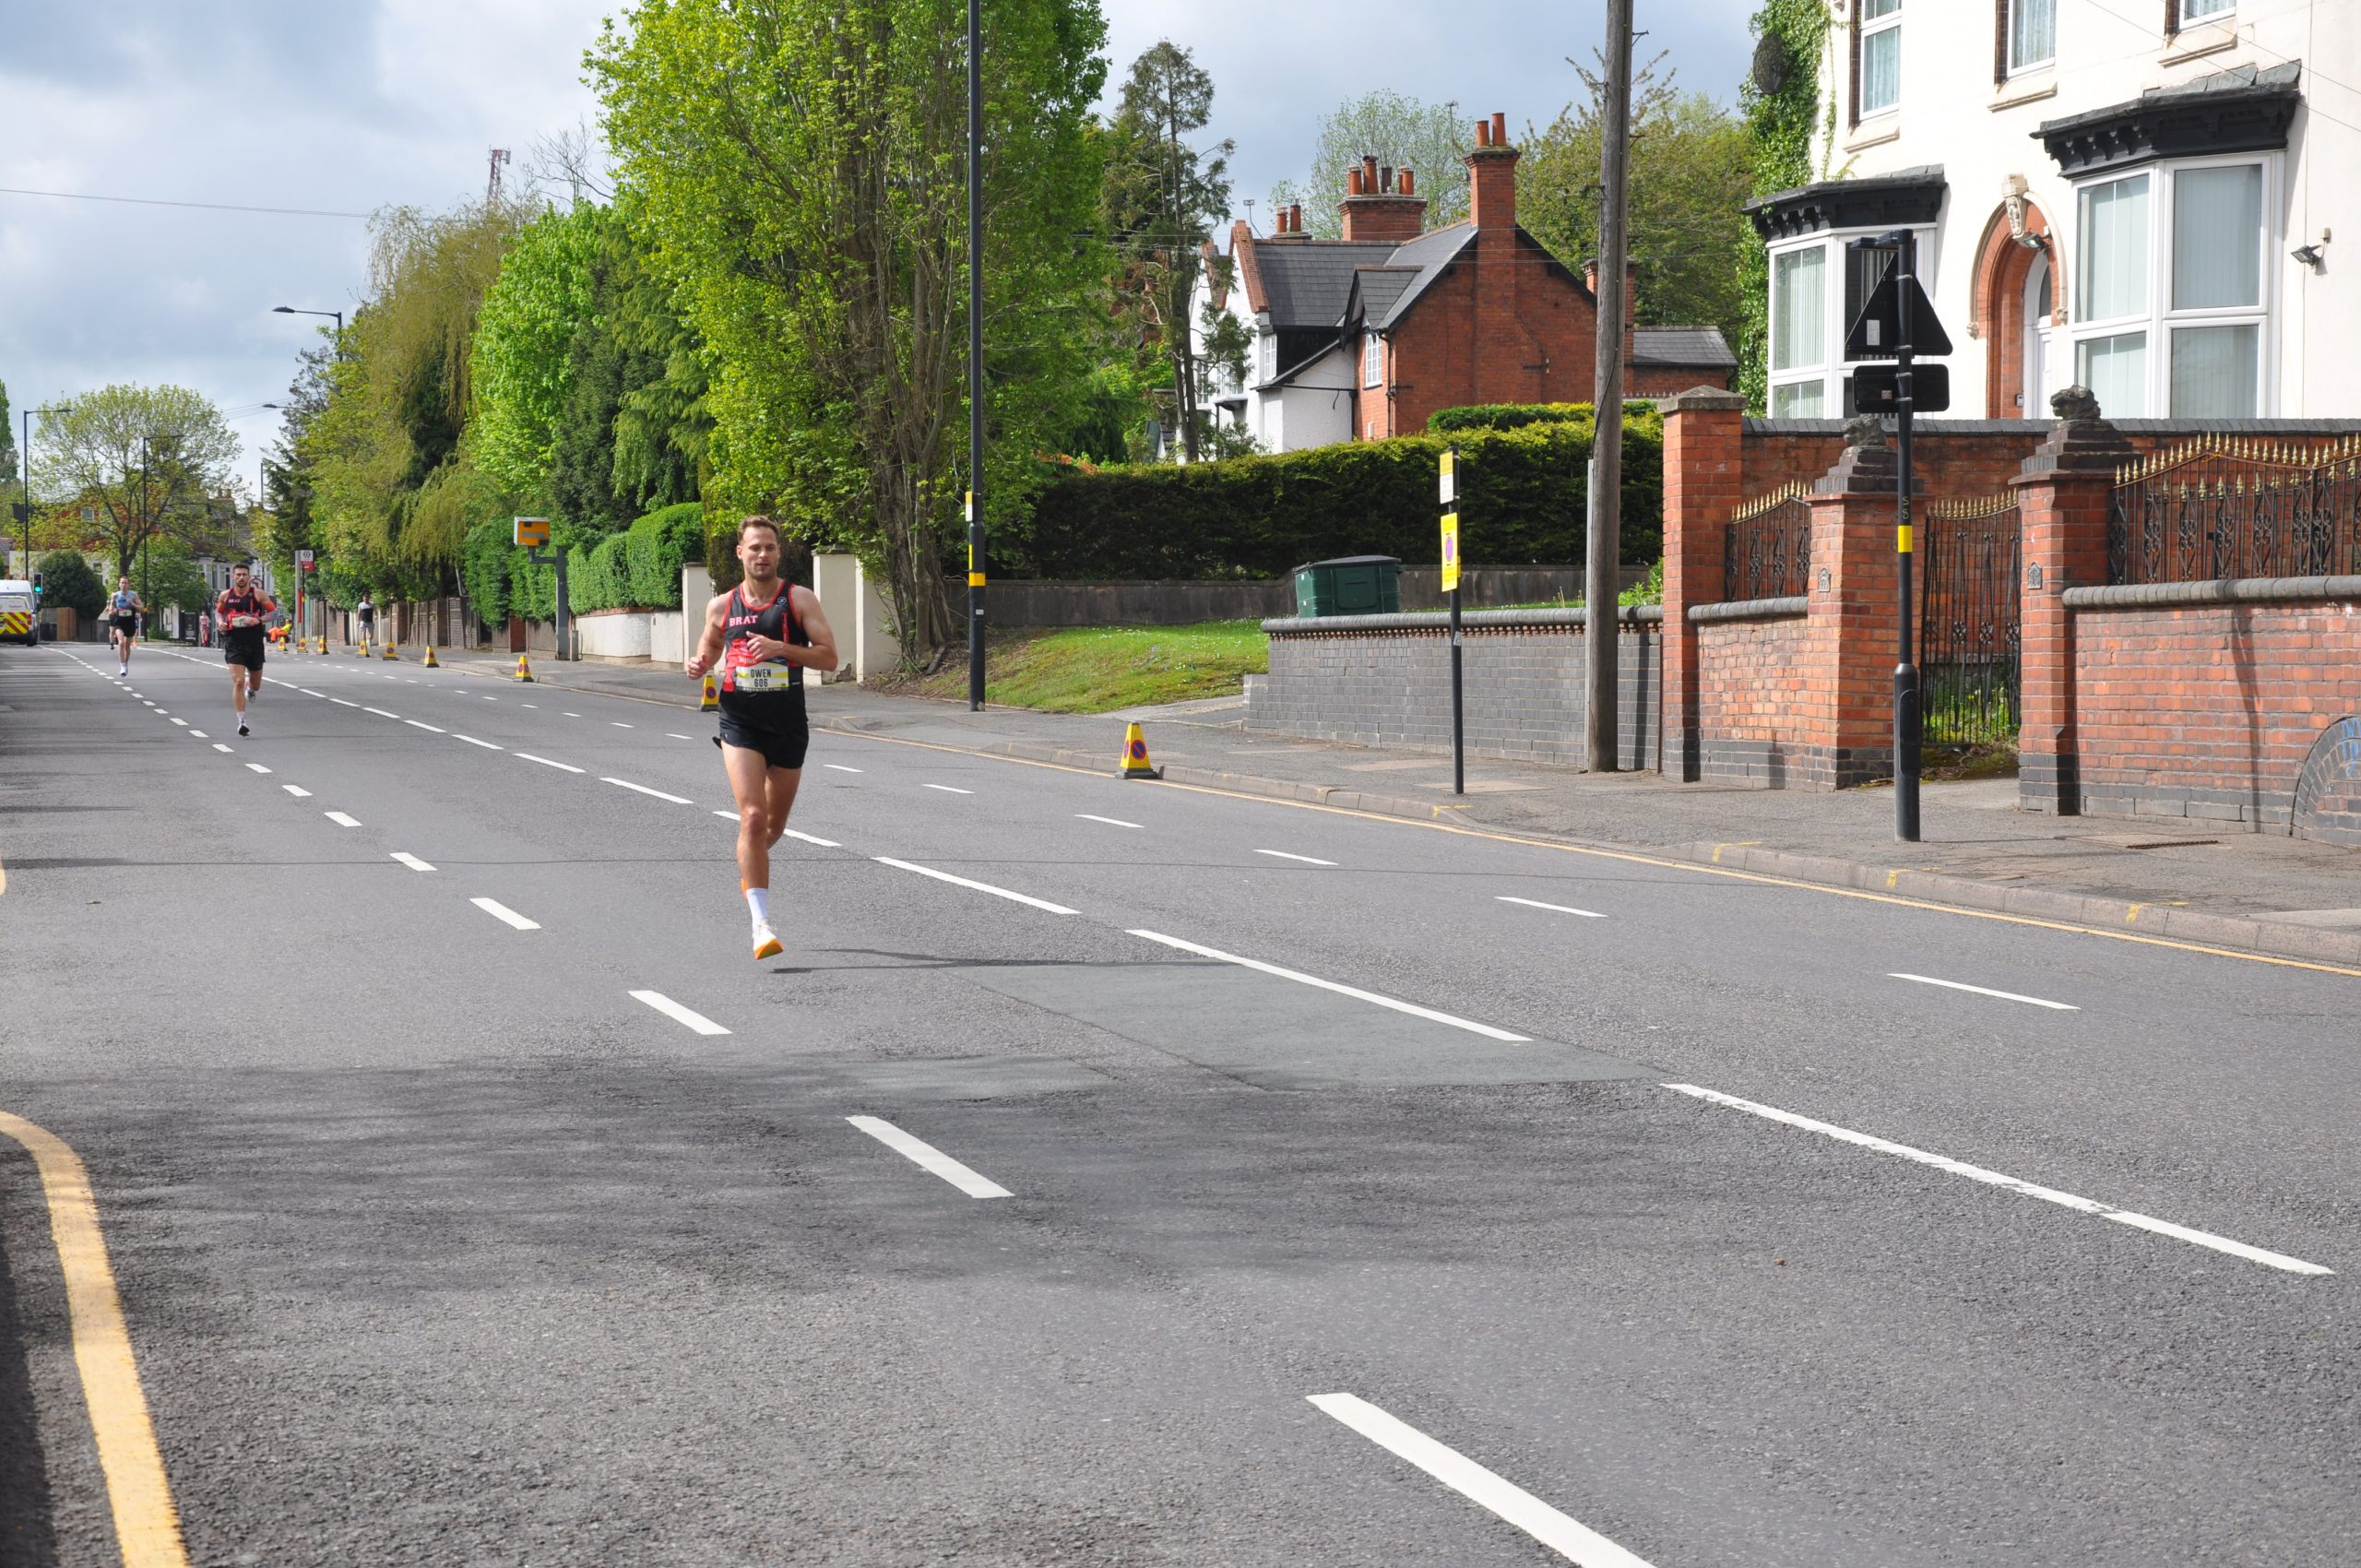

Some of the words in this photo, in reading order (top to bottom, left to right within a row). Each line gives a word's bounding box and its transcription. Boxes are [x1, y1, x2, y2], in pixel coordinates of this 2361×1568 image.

[730, 615, 758, 626] BRAT
[751, 669, 771, 677] OWEN
[754, 679, 768, 687] 606
